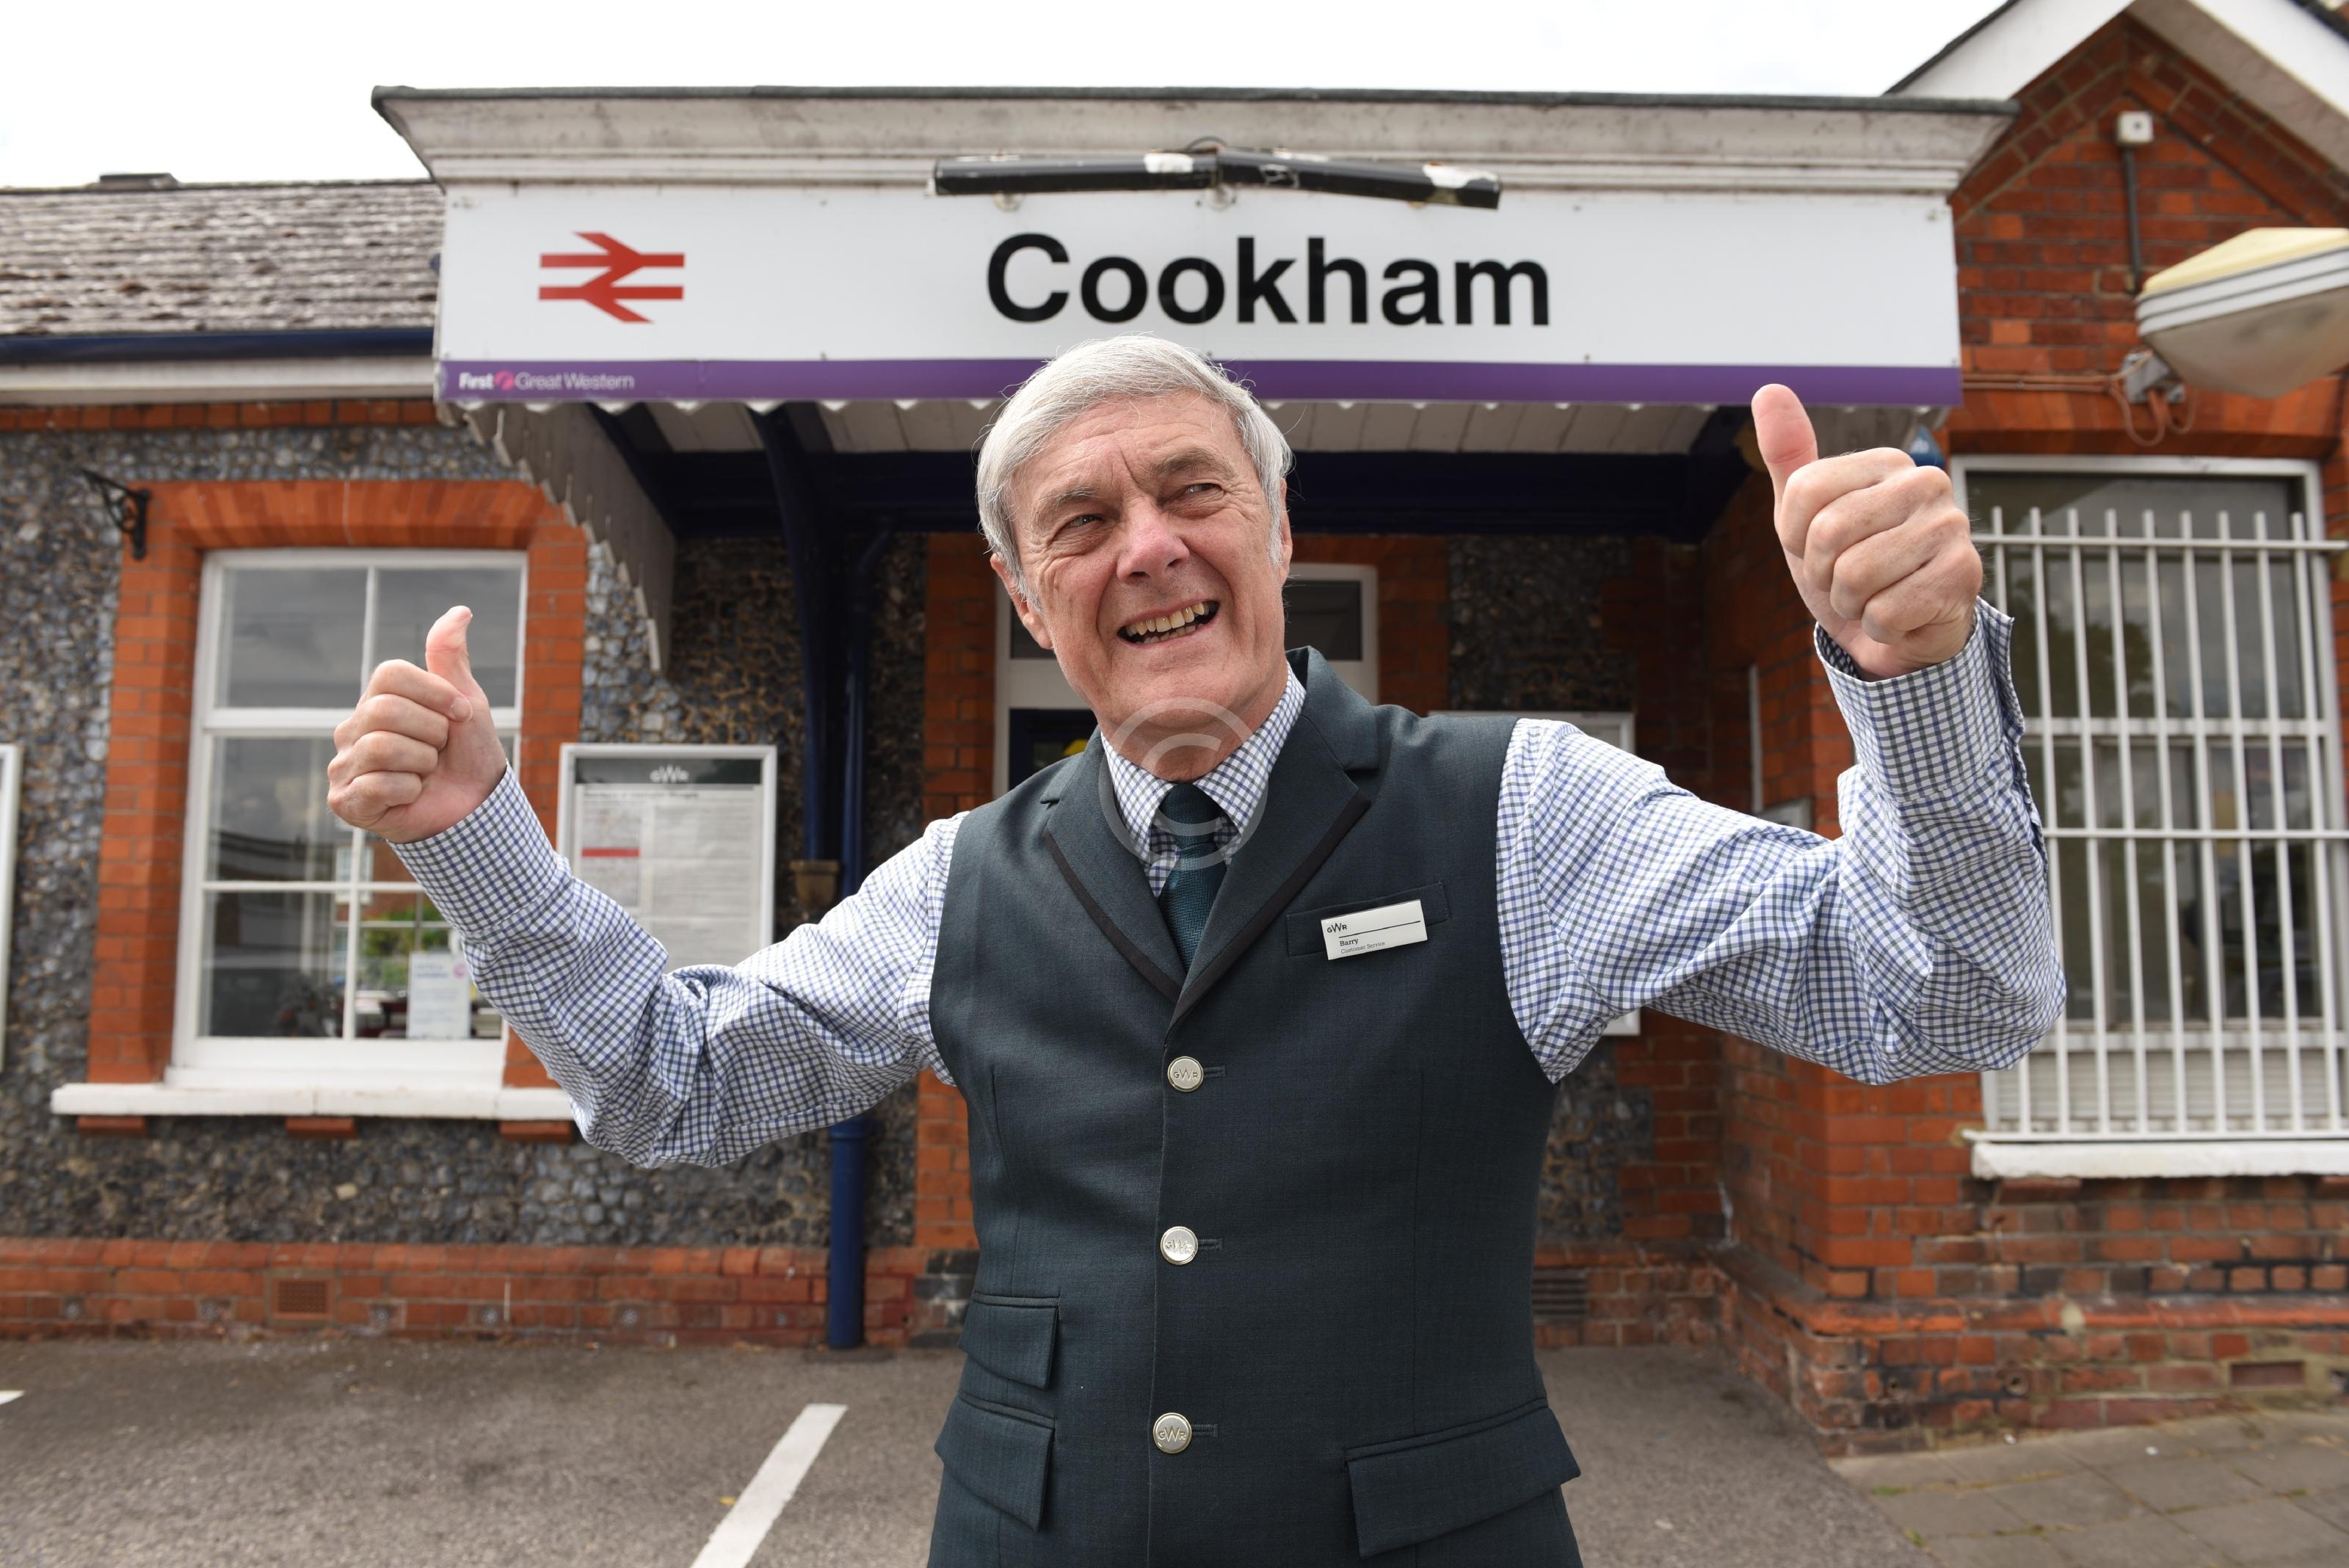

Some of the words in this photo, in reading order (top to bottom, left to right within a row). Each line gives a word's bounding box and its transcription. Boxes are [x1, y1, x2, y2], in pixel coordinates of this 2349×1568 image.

[987, 233, 1550, 326] Cookham
[459, 371, 495, 390] First
[515, 371, 562, 390] Great
[563, 372, 635, 390] Western
[1326, 923, 1348, 933] GWR
[1340, 938, 1359, 947] Barry
[1340, 945, 1366, 954] Customer
[1367, 941, 1386, 949] Service
[1173, 1067, 1199, 1081] GWR
[1158, 1425, 1187, 1442] GWR
